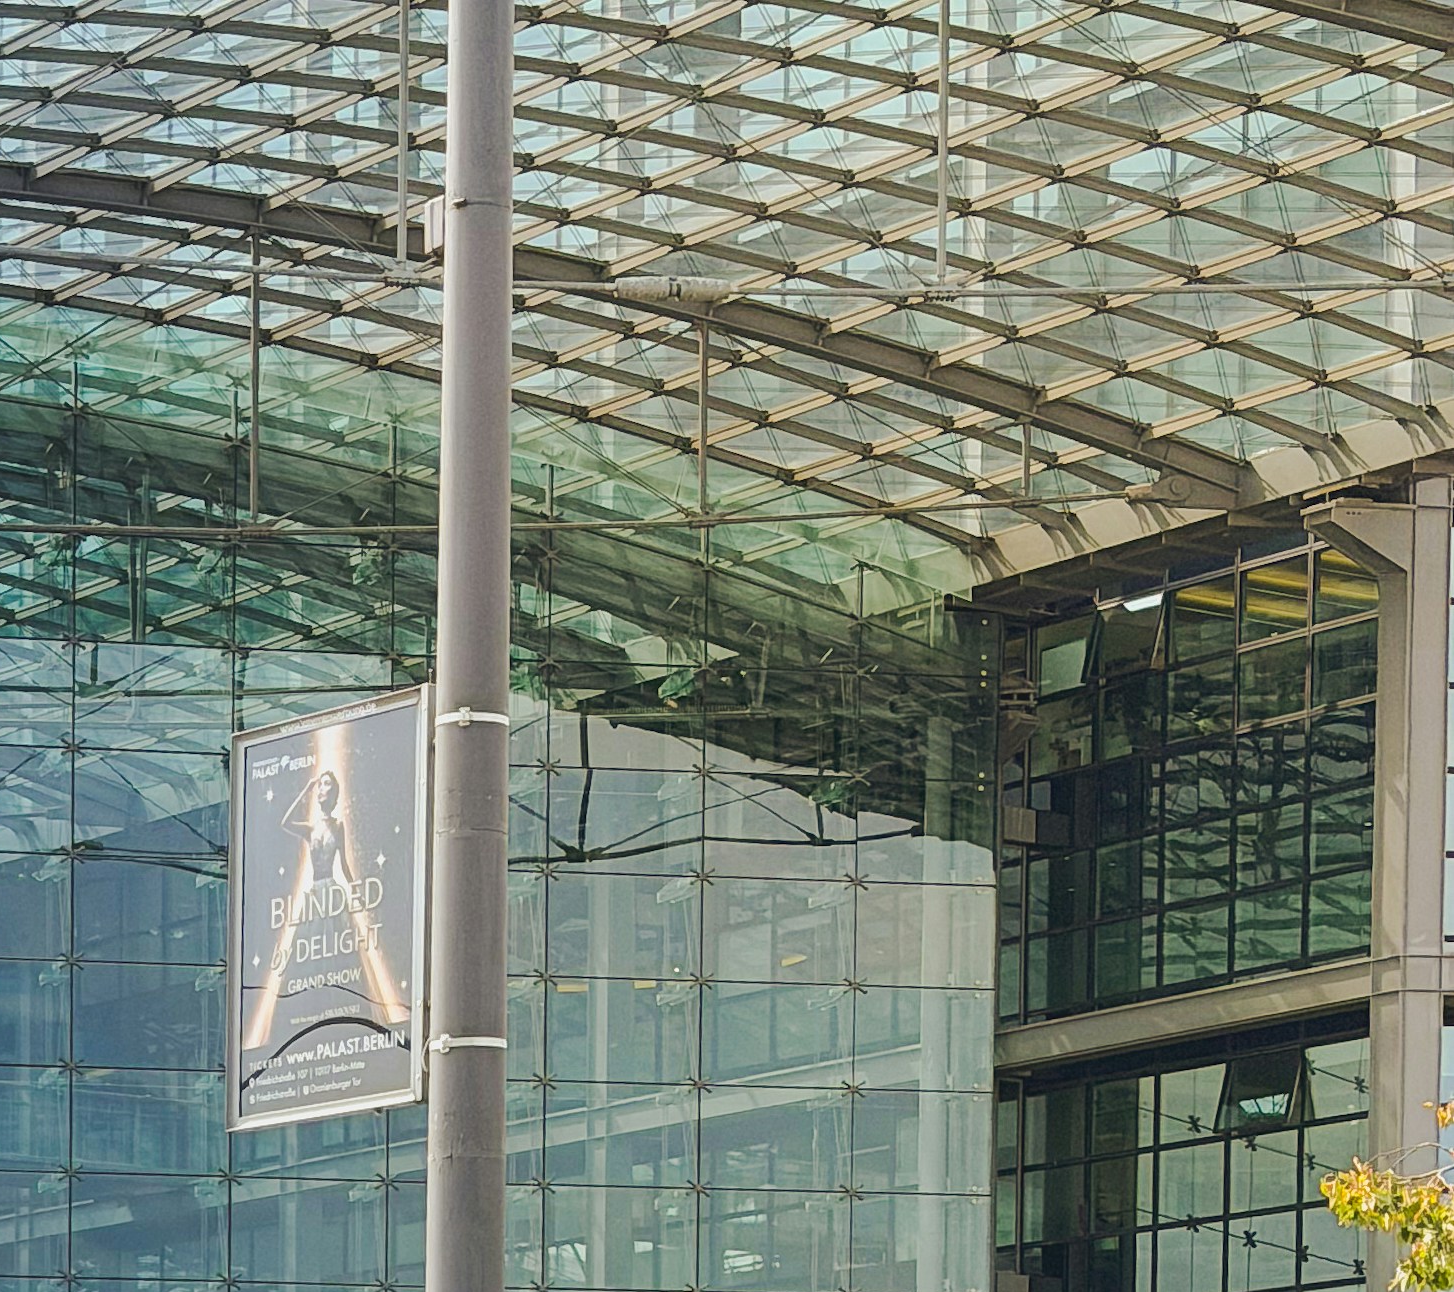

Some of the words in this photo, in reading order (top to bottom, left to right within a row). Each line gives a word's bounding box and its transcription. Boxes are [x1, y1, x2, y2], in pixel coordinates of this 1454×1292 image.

[252, 763, 279, 780] PALAST
[289, 755, 316, 772] BERLIN
[270, 877, 383, 929] BLINDED
[271, 943, 293, 977] by
[296, 923, 383, 963] DELIGHT
[288, 974, 325, 994] GRAND
[327, 967, 362, 987] SHOW
[249, 1056, 283, 1073] TICKETS
